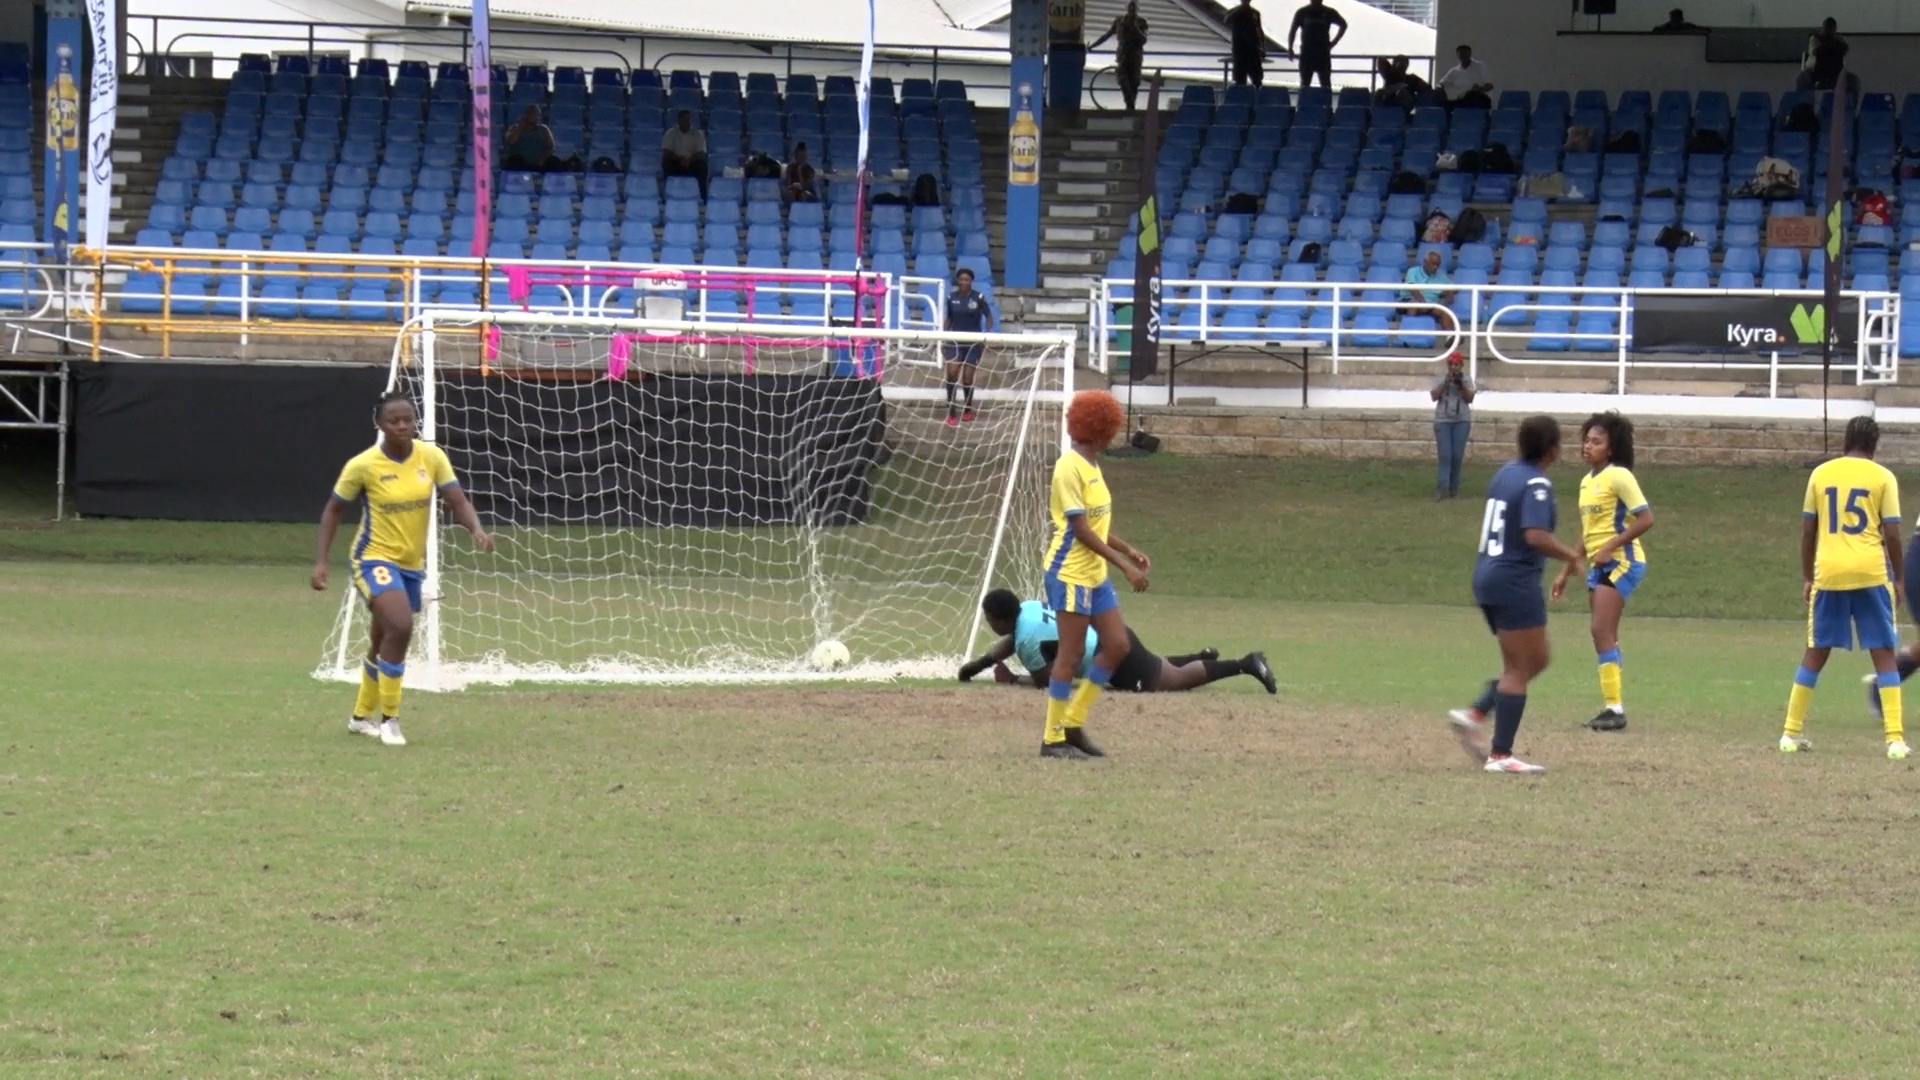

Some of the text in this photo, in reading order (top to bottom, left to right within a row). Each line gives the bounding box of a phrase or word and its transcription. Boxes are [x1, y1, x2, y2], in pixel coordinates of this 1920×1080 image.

[1010, 145, 1038, 157] Carib
[1728, 323, 1786, 347] Kyra.
[1824, 486, 1871, 535] 15
[1482, 498, 1508, 557] 15
[372, 565, 393, 588] 8
